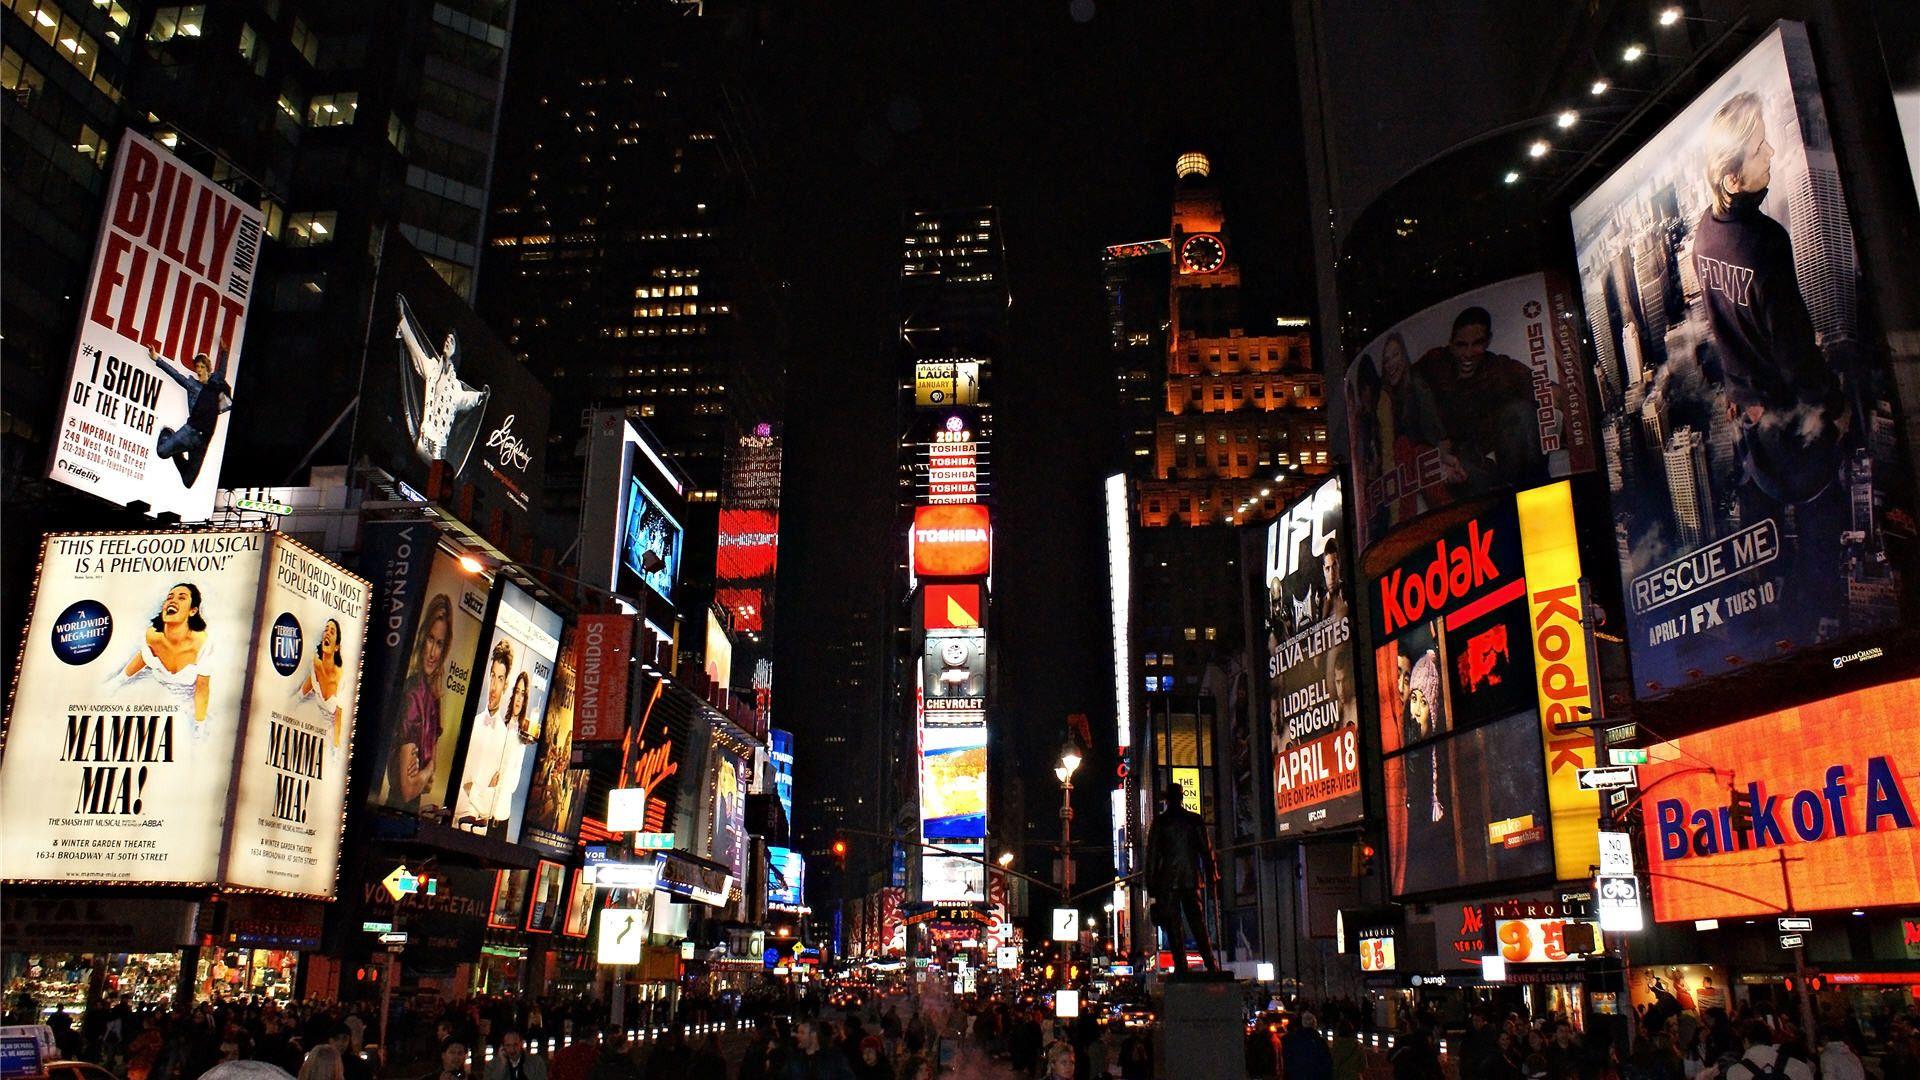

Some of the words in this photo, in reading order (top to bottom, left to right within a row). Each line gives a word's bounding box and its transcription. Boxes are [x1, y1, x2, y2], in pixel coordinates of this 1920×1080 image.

[113, 140, 241, 286] BILLY
[234, 214, 261, 275] MUSICAL
[228, 275, 249, 299] THE
[1697, 254, 1754, 307] FDNY
[91, 230, 244, 371] ELLIOT
[102, 355, 163, 410] SHOW
[917, 370, 958, 379] LAUGH
[917, 380, 950, 389] JANUARY
[1527, 323, 1560, 455] SOUTHPOLE
[73, 381, 92, 407] OF
[95, 390, 119, 420] THE
[64, 429, 81, 443] 249
[82, 437, 102, 452] West
[123, 453, 146, 471] Street
[78, 420, 116, 446] IMPERIAL
[119, 437, 150, 460] THEATRE
[931, 444, 976, 453] TOSHIBA
[936, 431, 971, 442] 2009
[68, 463, 101, 484] Fidelity
[931, 457, 976, 466] TOSHIBA
[931, 471, 976, 479] TOSHIBA
[931, 483, 976, 493] TOSHIBA
[99, 538, 186, 555] FEEL-GOOD
[190, 535, 260, 553] MUSICAL
[916, 529, 988, 543] TOSHIBA
[1265, 477, 1338, 589] UFC
[75, 556, 92, 573] IS
[93, 557, 105, 573] A
[278, 565, 319, 600] POPULAR
[299, 558, 338, 591] WORLD'S
[340, 580, 362, 603] MOST
[1380, 519, 1499, 635] Kodak
[1636, 548, 1726, 610] RESCUE
[1733, 525, 1773, 570] ME
[386, 525, 414, 648] VORNADO
[56, 615, 109, 633] WORLDWIDE
[1650, 619, 1680, 646] APRIL
[1681, 615, 1687, 635] 7
[1690, 597, 1724, 634] FX
[1725, 586, 1757, 618] TUES
[1758, 581, 1775, 606] 10
[1269, 642, 1304, 679] SILVA
[1307, 616, 1350, 660] LEITES
[446, 675, 466, 696] Case
[449, 660, 470, 681] Head
[581, 622, 604, 738] BIENVENIDOS
[1532, 584, 1596, 775] Kodak
[89, 704, 123, 712] ANDERSSON
[926, 698, 983, 709] CHEVROLET
[1282, 678, 1330, 718] LIDDELL
[59, 715, 174, 762] MAMMA
[265, 720, 324, 780] MAMMA
[1178, 778, 1193, 786] THE
[1277, 741, 1330, 794] APRIL
[1334, 731, 1357, 774] 18
[75, 766, 148, 816] MIA!
[272, 773, 310, 824] MIA!
[1278, 790, 1292, 810] LIVE
[1293, 789, 1303, 804] ON
[1305, 771, 1358, 801] PAY-PER-VIEW
[1792, 764, 1848, 842] of
[1866, 755, 1914, 833] A
[48, 818, 60, 826] THE
[61, 818, 82, 826] SMASH
[83, 818, 94, 826] HIT
[95, 819, 121, 827] MUSICAL
[1490, 817, 1522, 836] make
[1507, 831, 1540, 845] something
[36, 851, 55, 860] 1634
[57, 851, 101, 860] BROADWAY
[105, 852, 115, 860] AT
[117, 852, 138, 861] 50TH
[140, 852, 168, 861] STREET
[61, 840, 90, 848] WINTER
[91, 840, 122, 848] GARDEN
[124, 840, 156, 849] THEATRE
[1608, 839, 1622, 851] NO
[1360, 941, 1372, 970] 9
[1373, 940, 1385, 969] 5
[1498, 920, 1533, 962] 9
